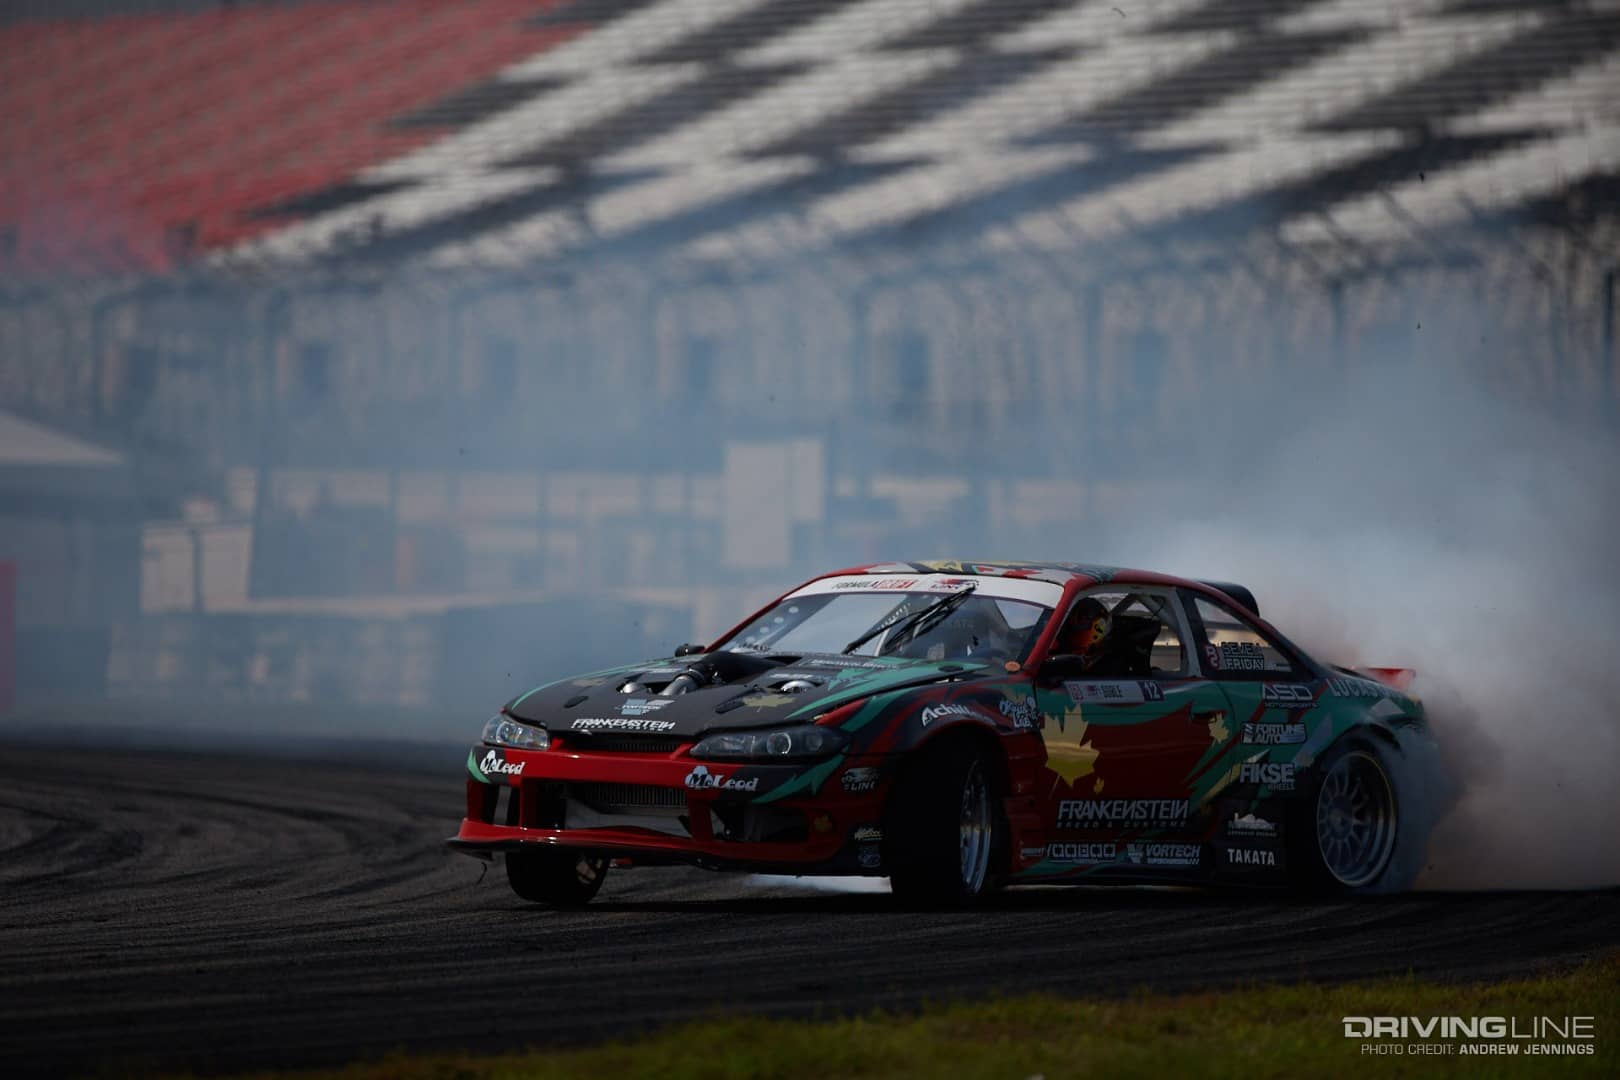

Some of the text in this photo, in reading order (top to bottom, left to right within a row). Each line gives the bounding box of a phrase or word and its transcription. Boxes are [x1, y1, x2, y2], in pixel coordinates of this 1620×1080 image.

[1144, 681, 1161, 699] 12
[1256, 724, 1305, 735] FORTUNE
[1255, 734, 1281, 744] AUTO
[1239, 763, 1296, 784] FIKSE
[1145, 843, 1200, 858] VORTECH
[1227, 848, 1275, 866] TAKATA
